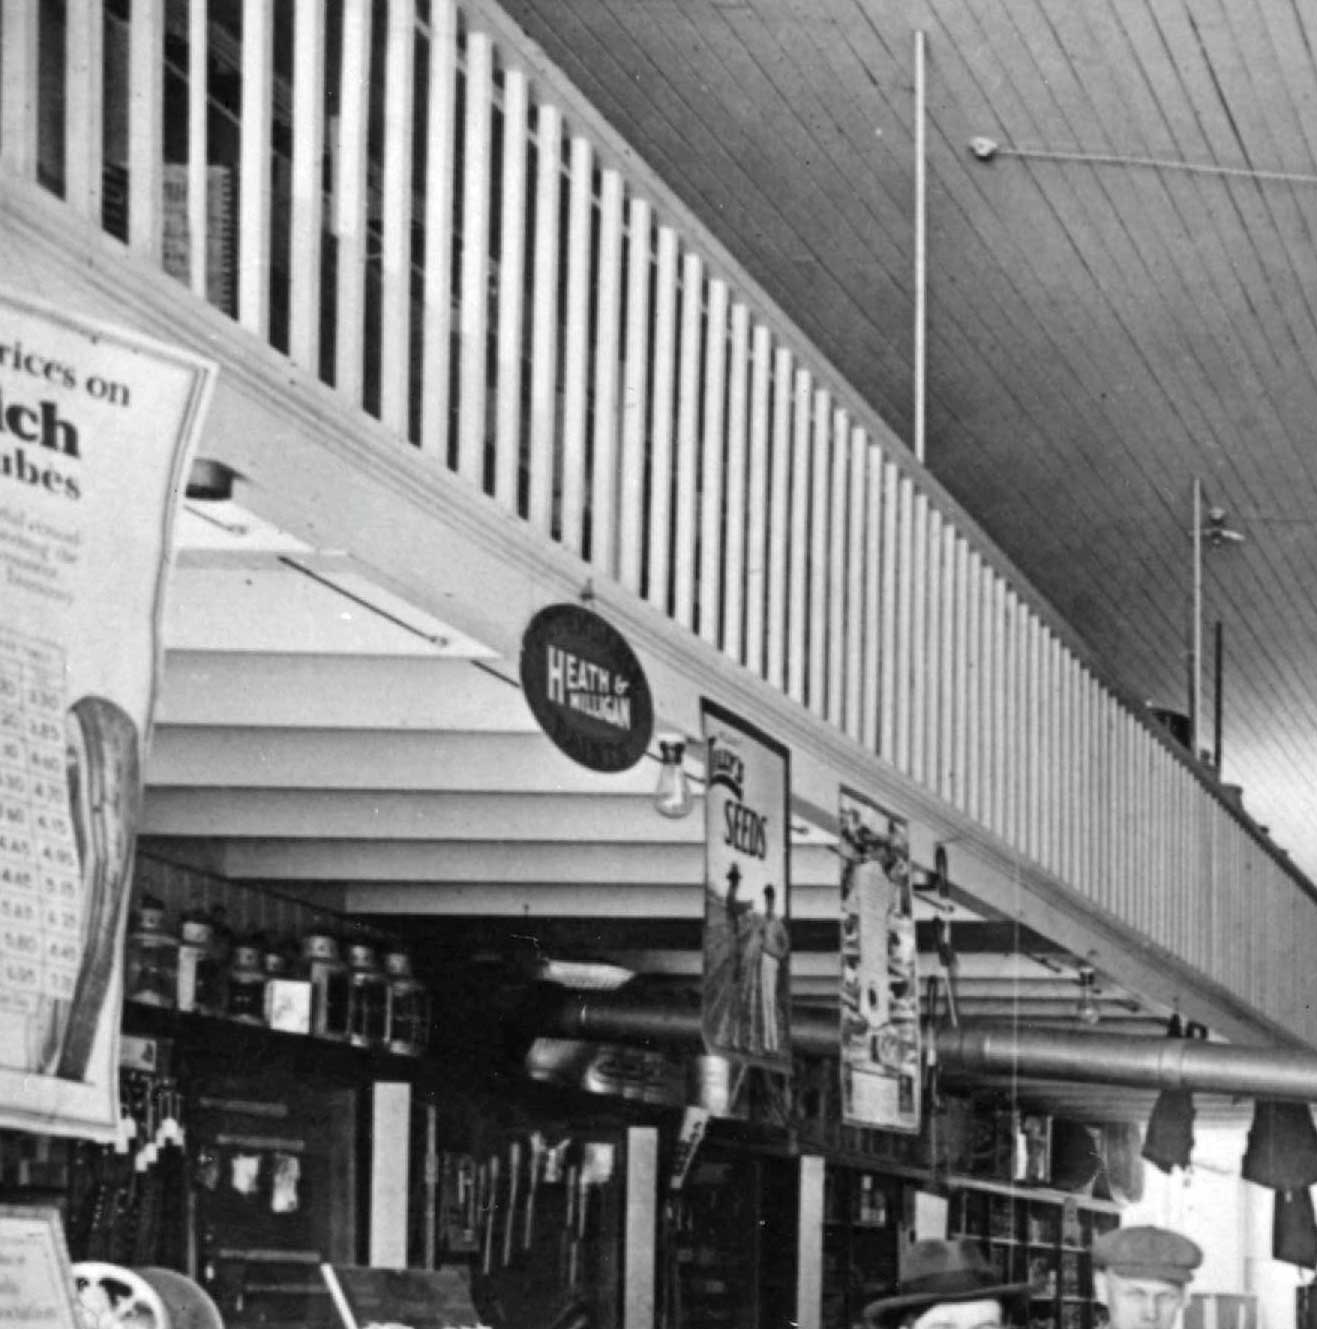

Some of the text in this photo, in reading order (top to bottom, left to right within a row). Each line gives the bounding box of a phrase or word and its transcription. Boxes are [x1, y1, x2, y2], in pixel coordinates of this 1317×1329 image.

[86, 376, 130, 406] on
[0, 399, 80, 458] ch
[546, 643, 630, 706] HEATH &
[569, 691, 631, 731] MILLIGAN
[723, 799, 767, 861] SEEDS
